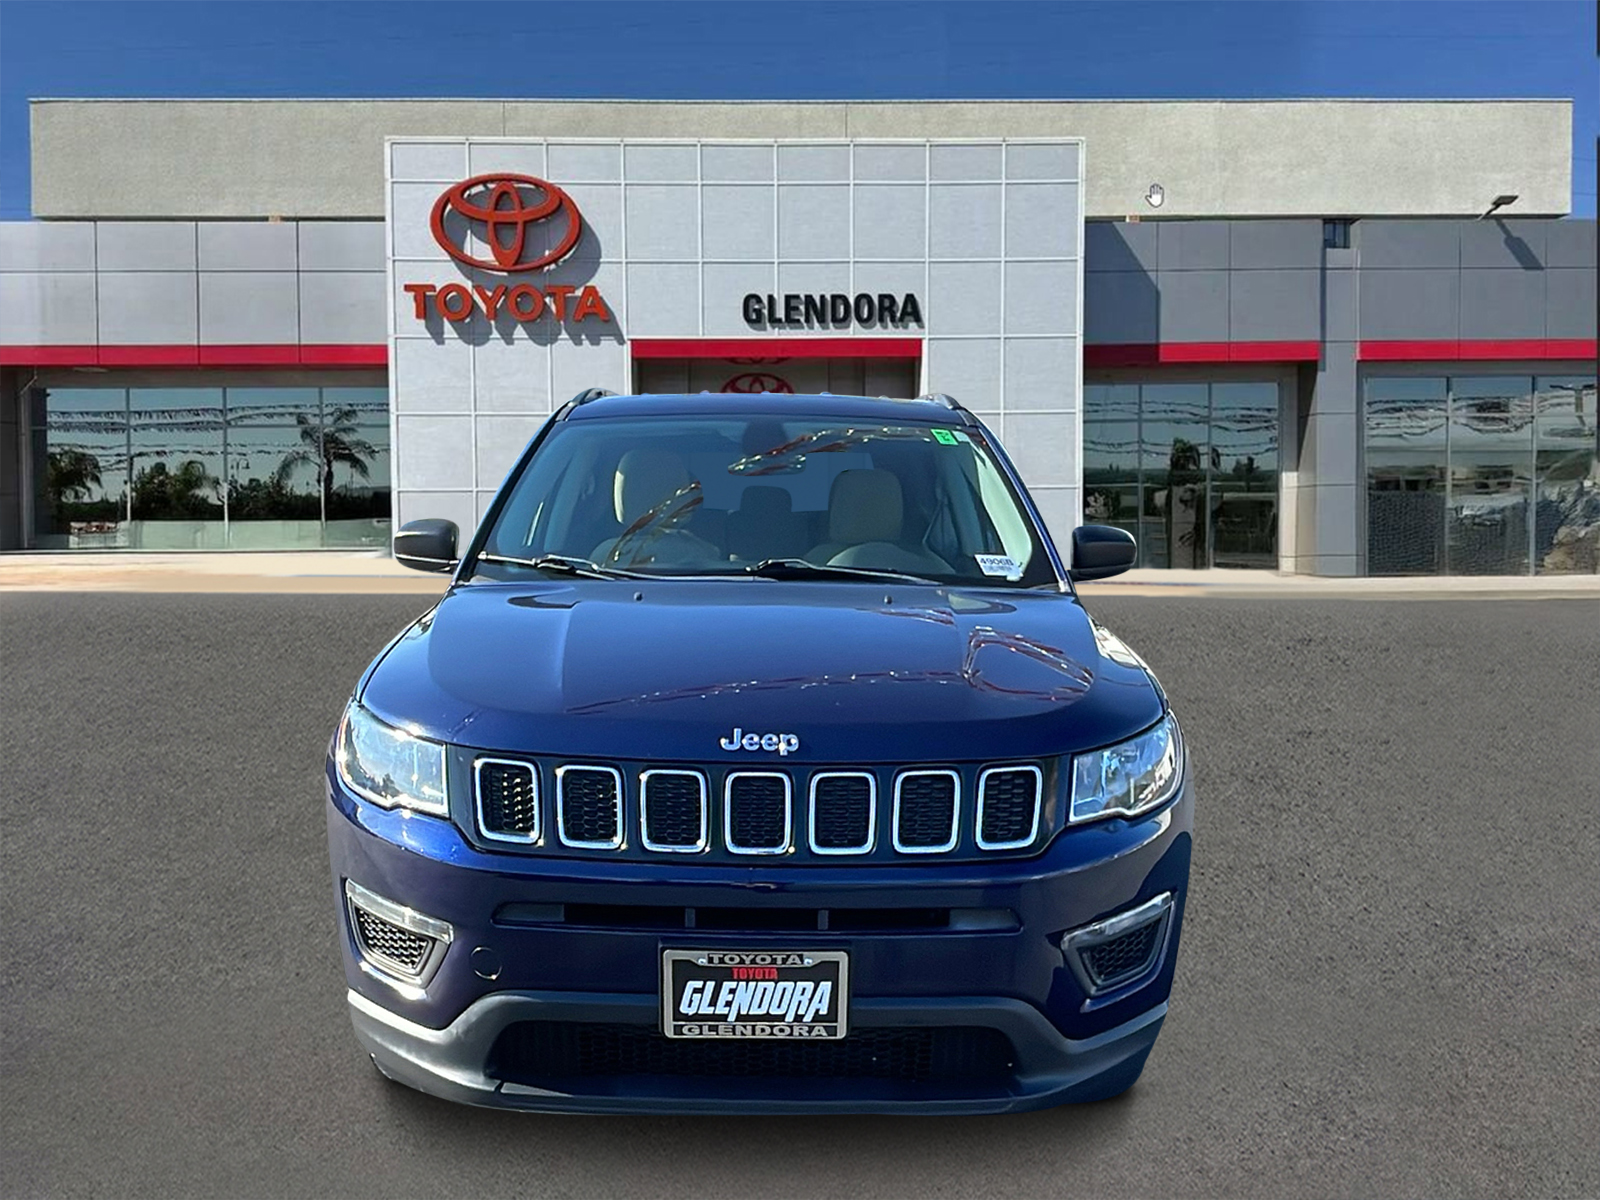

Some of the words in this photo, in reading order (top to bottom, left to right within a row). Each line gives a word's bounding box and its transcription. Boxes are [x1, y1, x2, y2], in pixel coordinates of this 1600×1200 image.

[403, 283, 610, 322] TOYOTA
[742, 292, 922, 326] GLENDORA
[720, 727, 799, 756] Jeep
[709, 953, 801, 965] TOYOTA
[732, 967, 778, 980] TOYOTA
[679, 981, 832, 1022] GLENDORA
[681, 1025, 829, 1037] GLENDORA
